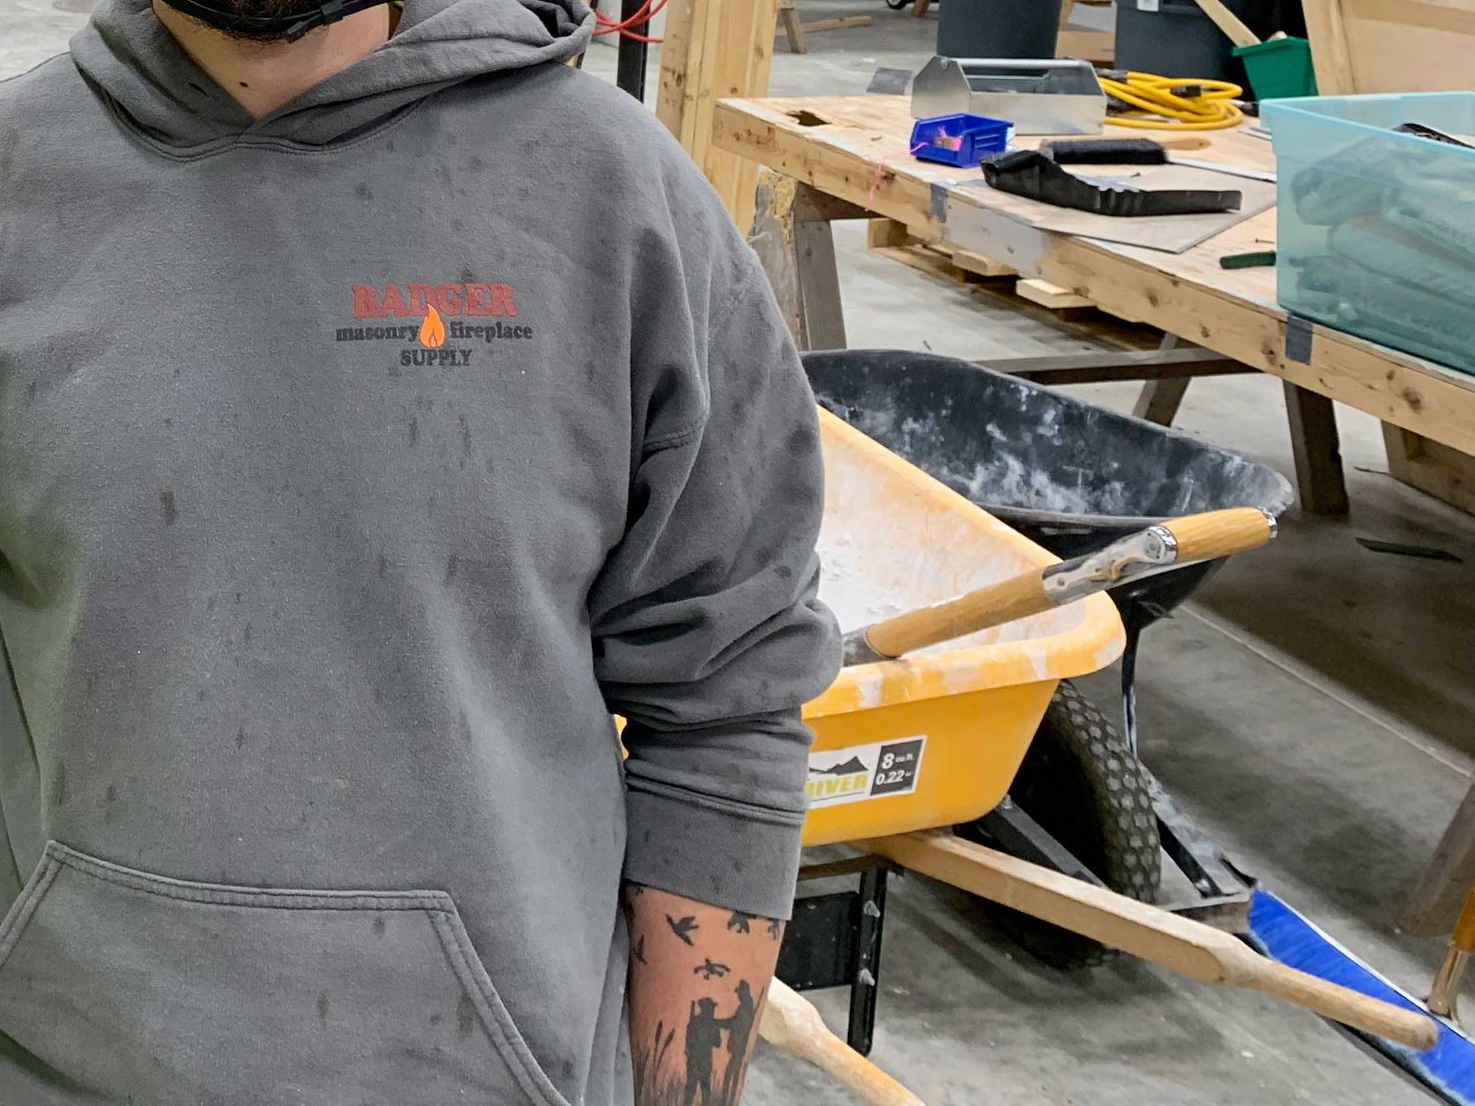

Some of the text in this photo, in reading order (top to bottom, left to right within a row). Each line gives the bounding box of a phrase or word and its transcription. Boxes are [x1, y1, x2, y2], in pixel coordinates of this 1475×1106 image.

[351, 282, 518, 319] BADGER
[336, 321, 533, 343] masonry fireplace
[400, 349, 473, 367] SUPPLY
[881, 753, 895, 769] 8
[876, 770, 905, 785] 0.22
